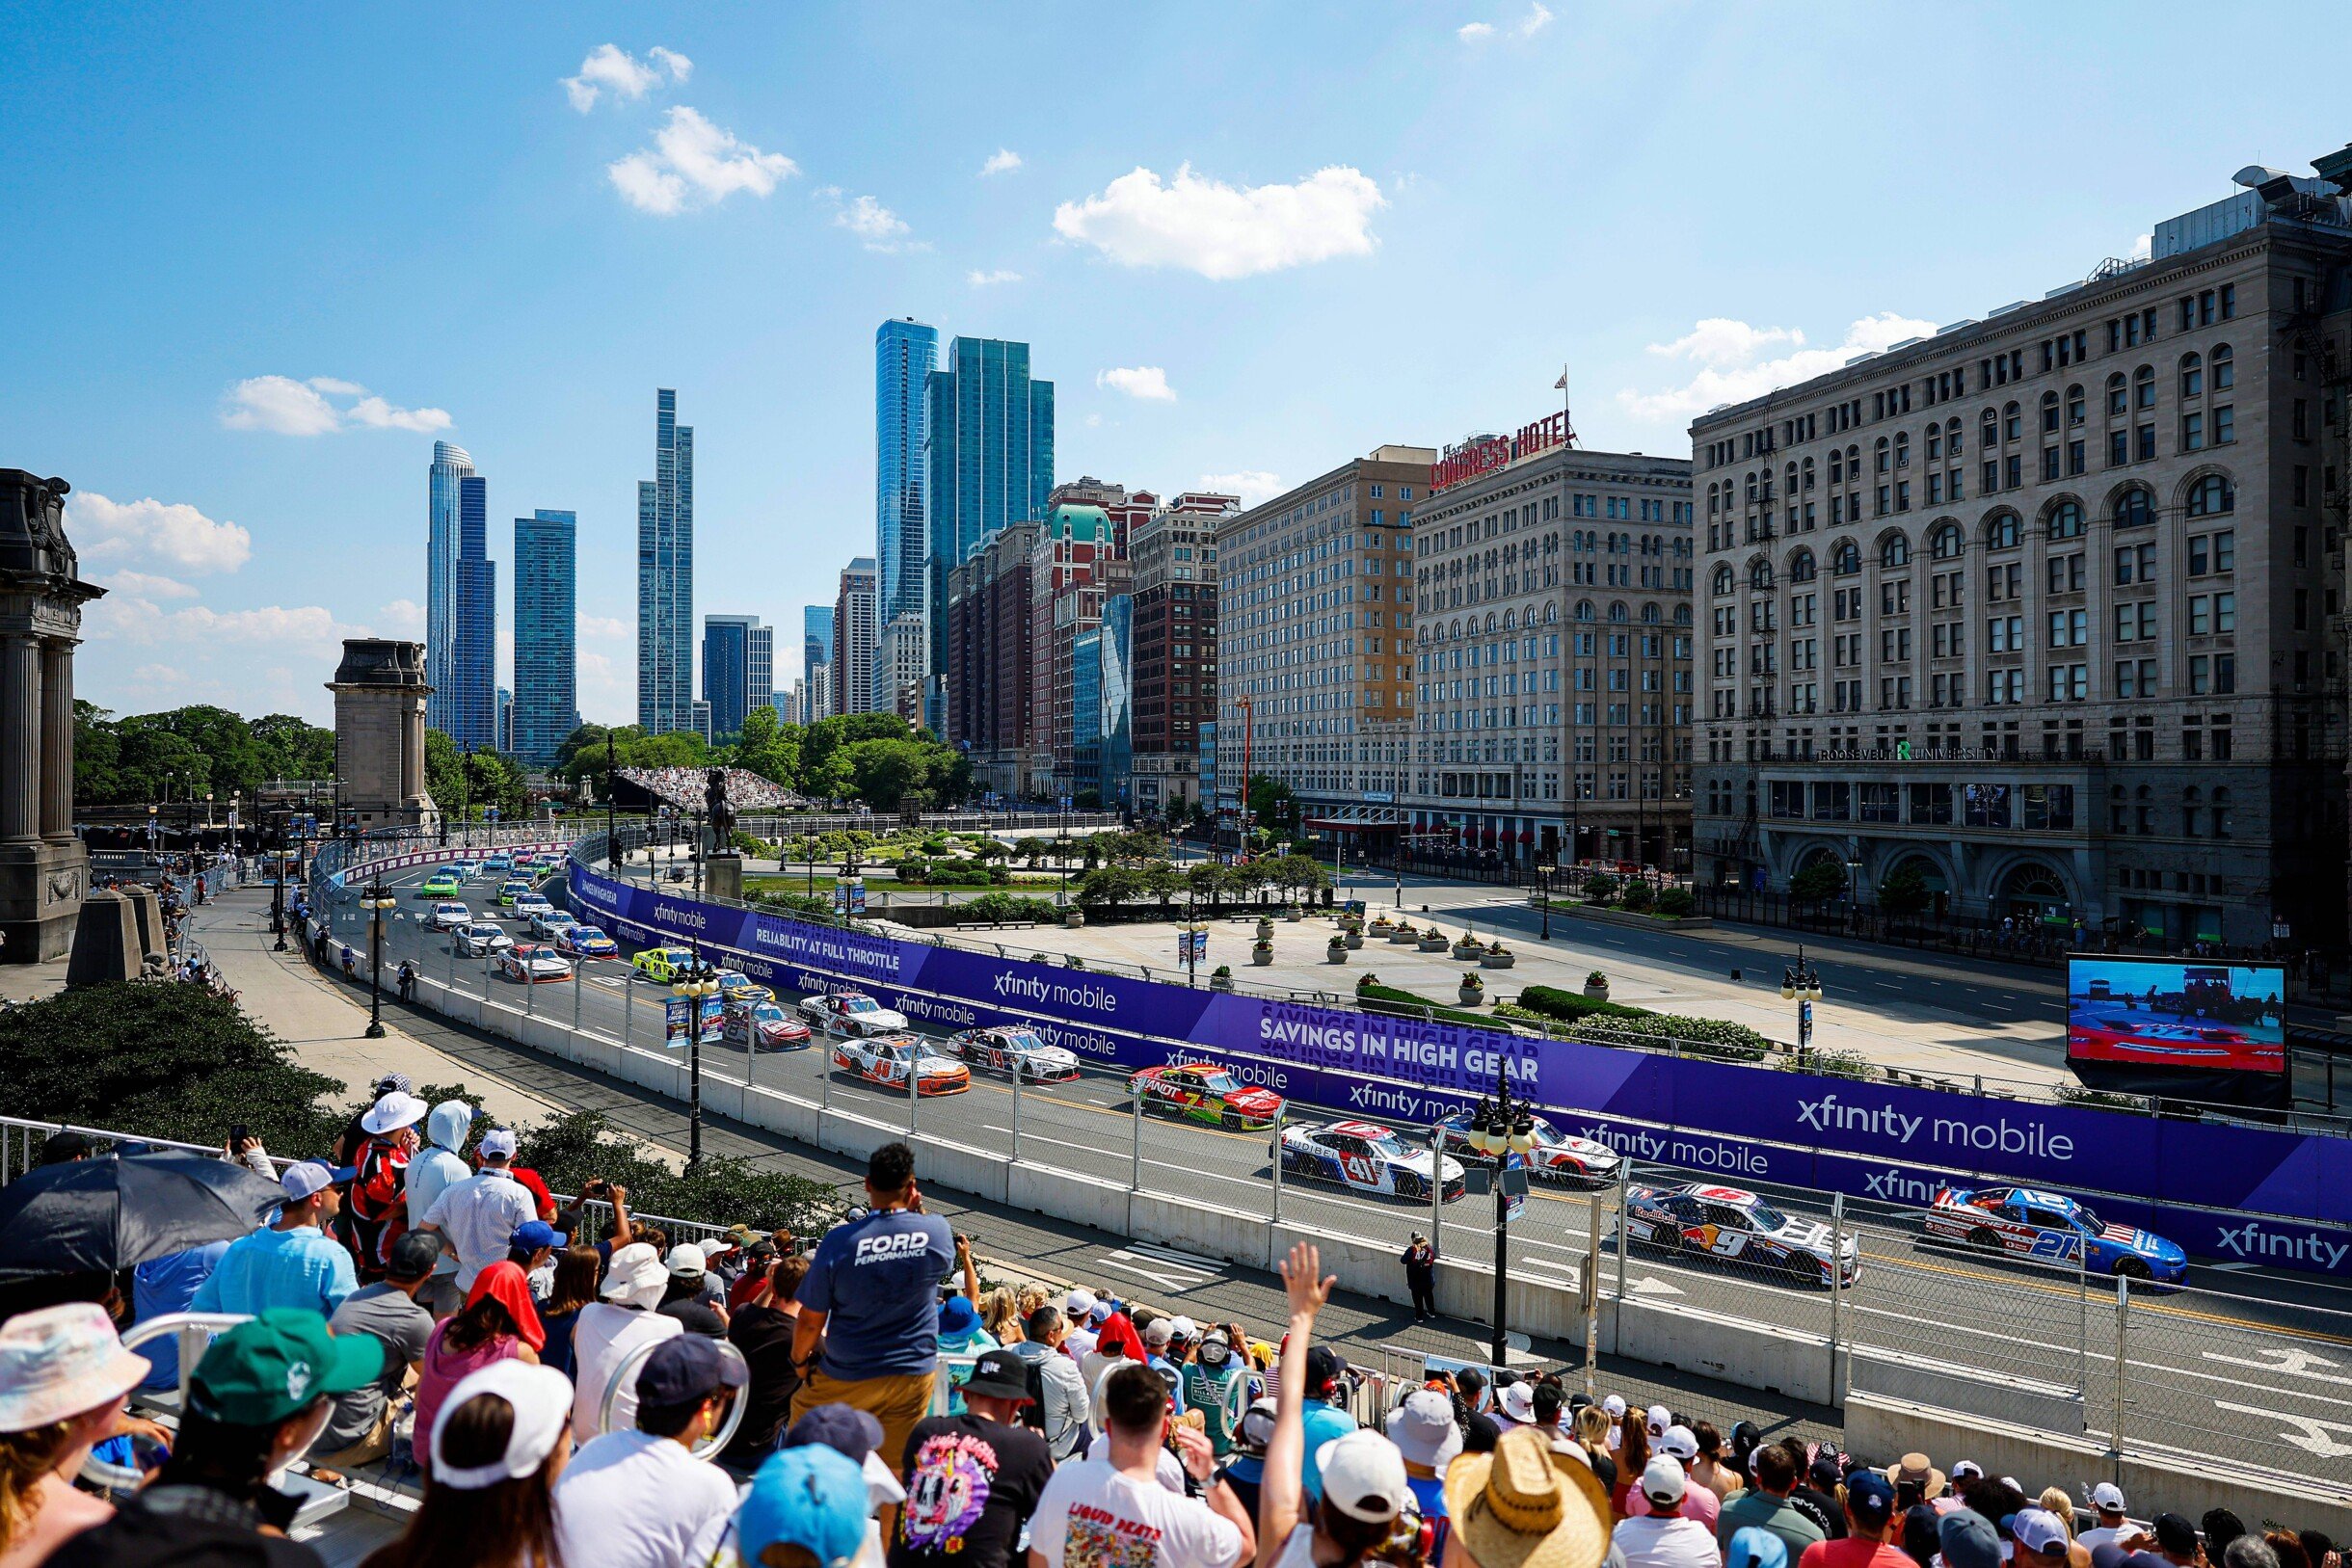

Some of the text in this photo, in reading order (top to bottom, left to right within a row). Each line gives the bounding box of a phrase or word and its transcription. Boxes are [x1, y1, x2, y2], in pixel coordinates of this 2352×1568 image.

[1430, 409, 1576, 491] CONGRESS HOTEL
[1820, 749, 1893, 761] ROOSEVELT
[1914, 747, 1998, 761] UNIVERSITY
[654, 903, 707, 929] xfinity mobile
[617, 922, 646, 943] xfinity mobile
[756, 928, 808, 952] RELIABILITY
[809, 942, 821, 955] AT
[822, 941, 845, 960] FULL
[847, 947, 899, 970] THROTTLE
[721, 953, 745, 973] xfinity
[746, 960, 772, 978] mobile
[798, 971, 829, 995] xfinity
[994, 970, 1116, 1012] xfinity mobile
[895, 995, 976, 1025] xfinity mobile
[1016, 1020, 1116, 1056] xfinity mobile
[1260, 1018, 1538, 1082] SAVINGS IN HIGH GEAR
[873, 1058, 892, 1077] 48
[988, 1048, 1004, 1070] 19
[1226, 1062, 1288, 1089] mobile
[1182, 1092, 1201, 1111] 7
[1350, 1082, 1421, 1119] xfinity
[1797, 1094, 2074, 1160] xfinity mobile
[1581, 1123, 1667, 1162] xfinity
[1671, 1140, 1769, 1175] mobile
[1348, 1156, 1375, 1183] 41
[1865, 1168, 1947, 1202] xfinit
[1635, 1205, 1677, 1225] Red Bull
[854, 1247, 927, 1267] PERFORMANCE
[856, 1232, 929, 1257] FORD
[1708, 1230, 1749, 1257] 9
[2031, 1230, 2078, 1259] 21
[2218, 1222, 2350, 1270] xfinity
[1068, 1502, 1114, 1525] LIQUID
[1115, 1519, 1163, 1540] DEATH
